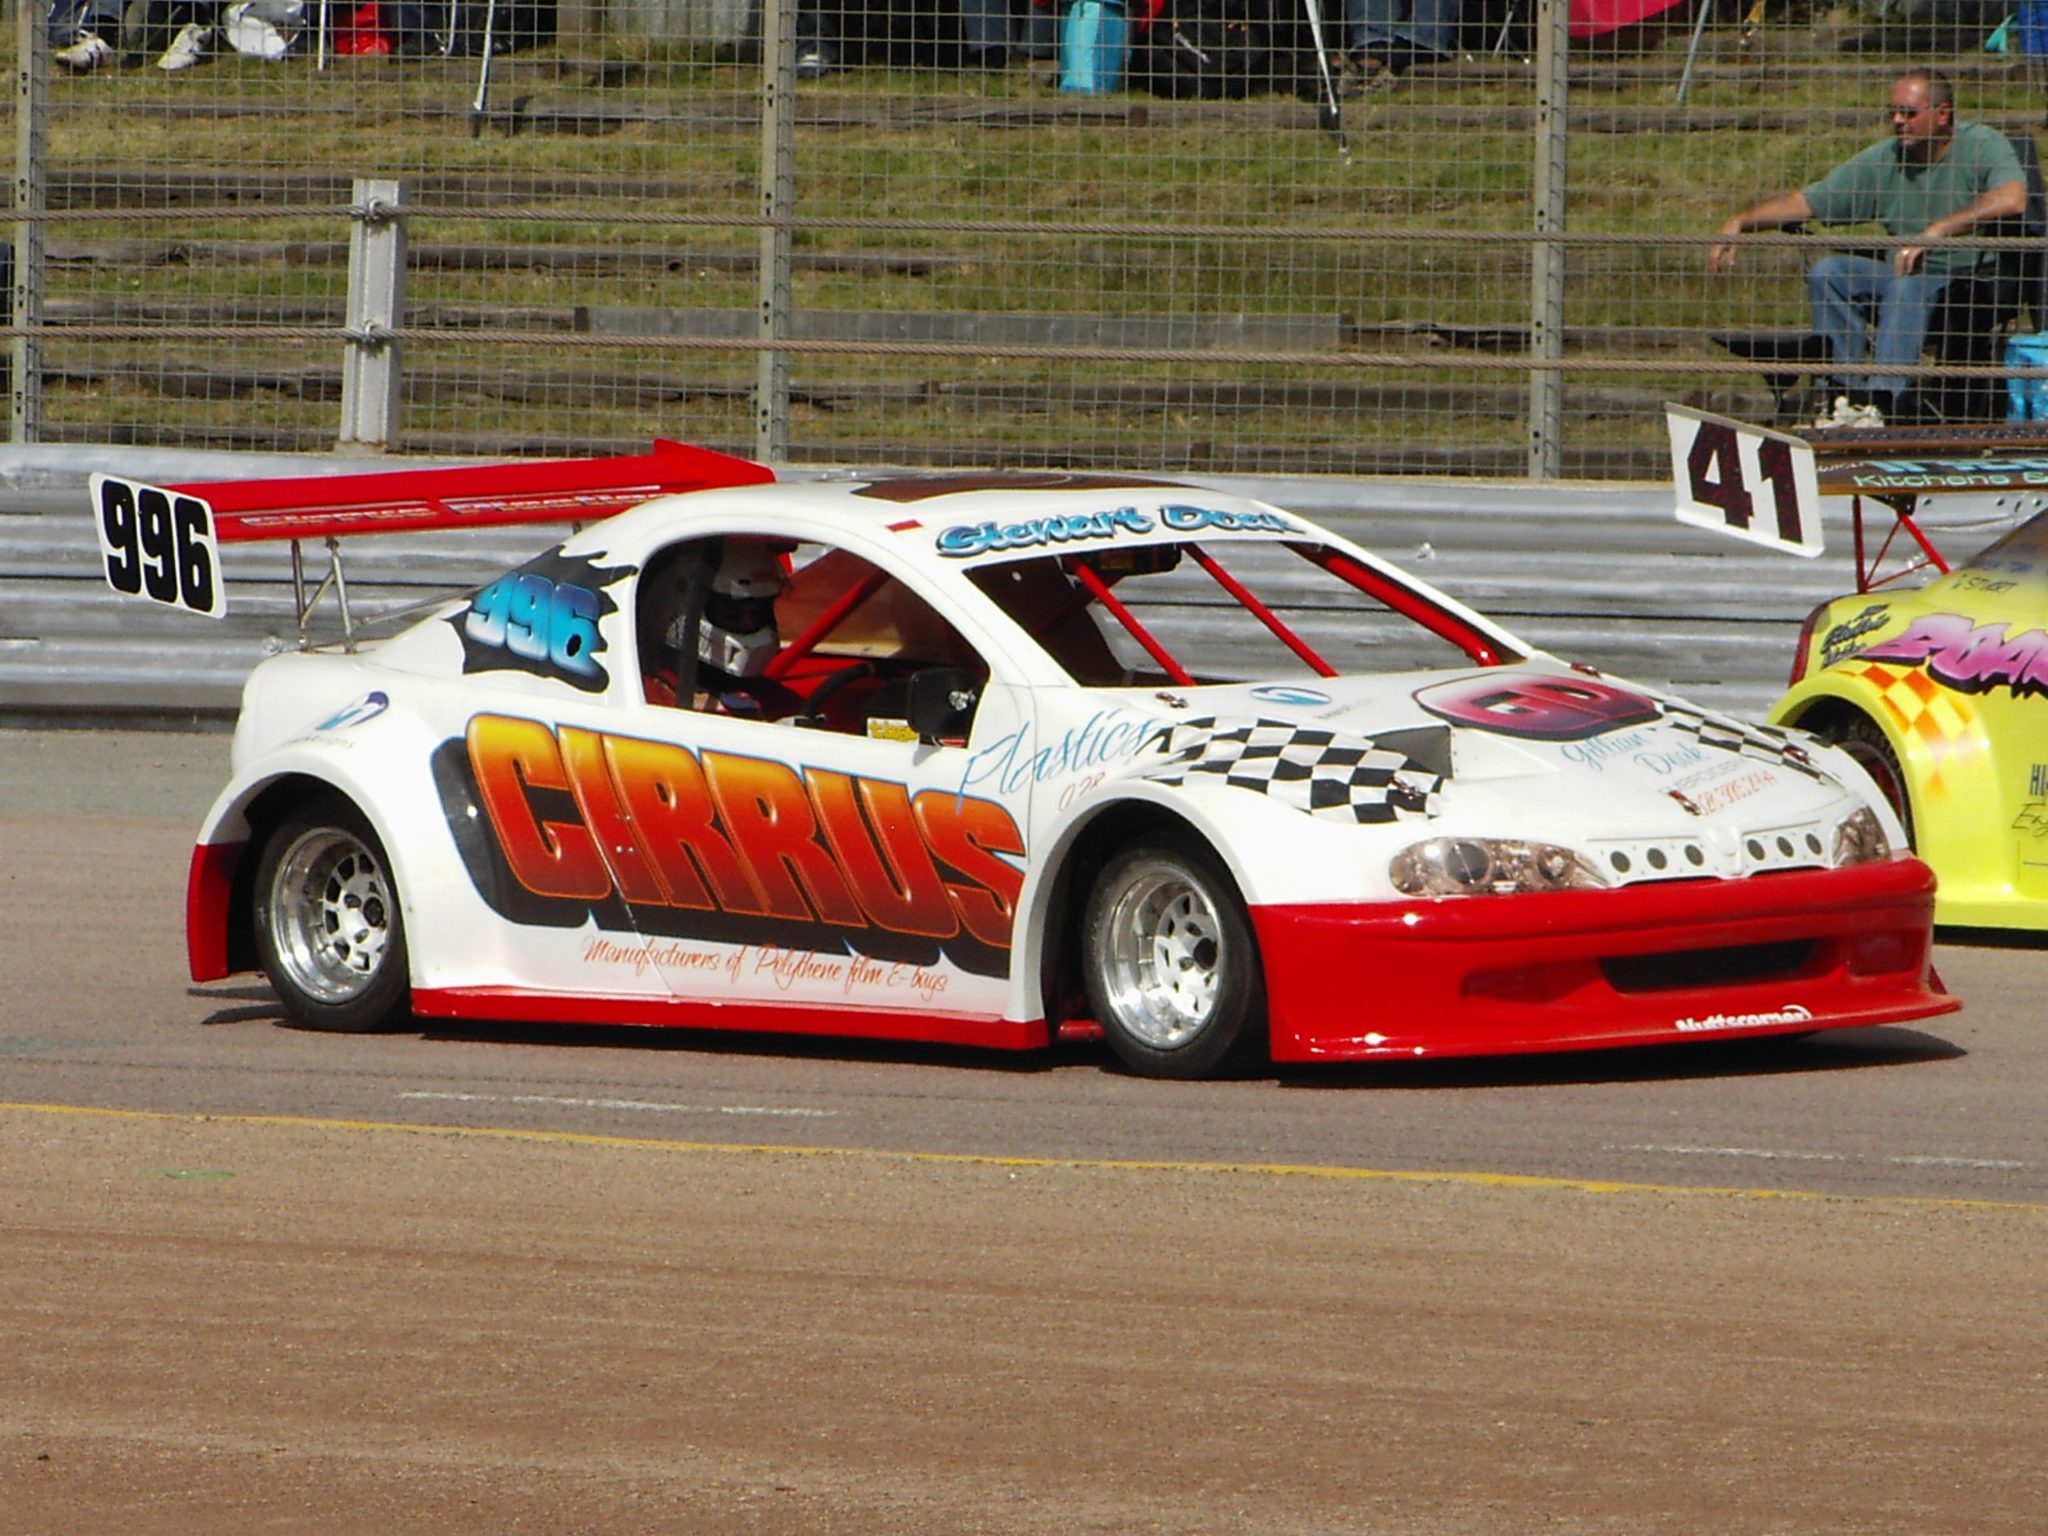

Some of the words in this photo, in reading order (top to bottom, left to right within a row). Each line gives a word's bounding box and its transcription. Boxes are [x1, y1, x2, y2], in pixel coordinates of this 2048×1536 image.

[936, 506, 1155, 555] Stewart
[1687, 420, 1803, 545] 41
[1853, 474, 2010, 487] Kitchens
[100, 479, 213, 612] 996
[465, 573, 602, 677] 996
[466, 713, 1026, 948] CIRRUS
[582, 936, 719, 976] Manufacturers
[725, 945, 748, 983] of
[754, 943, 841, 990] Polythene
[911, 963, 948, 1002] bags
